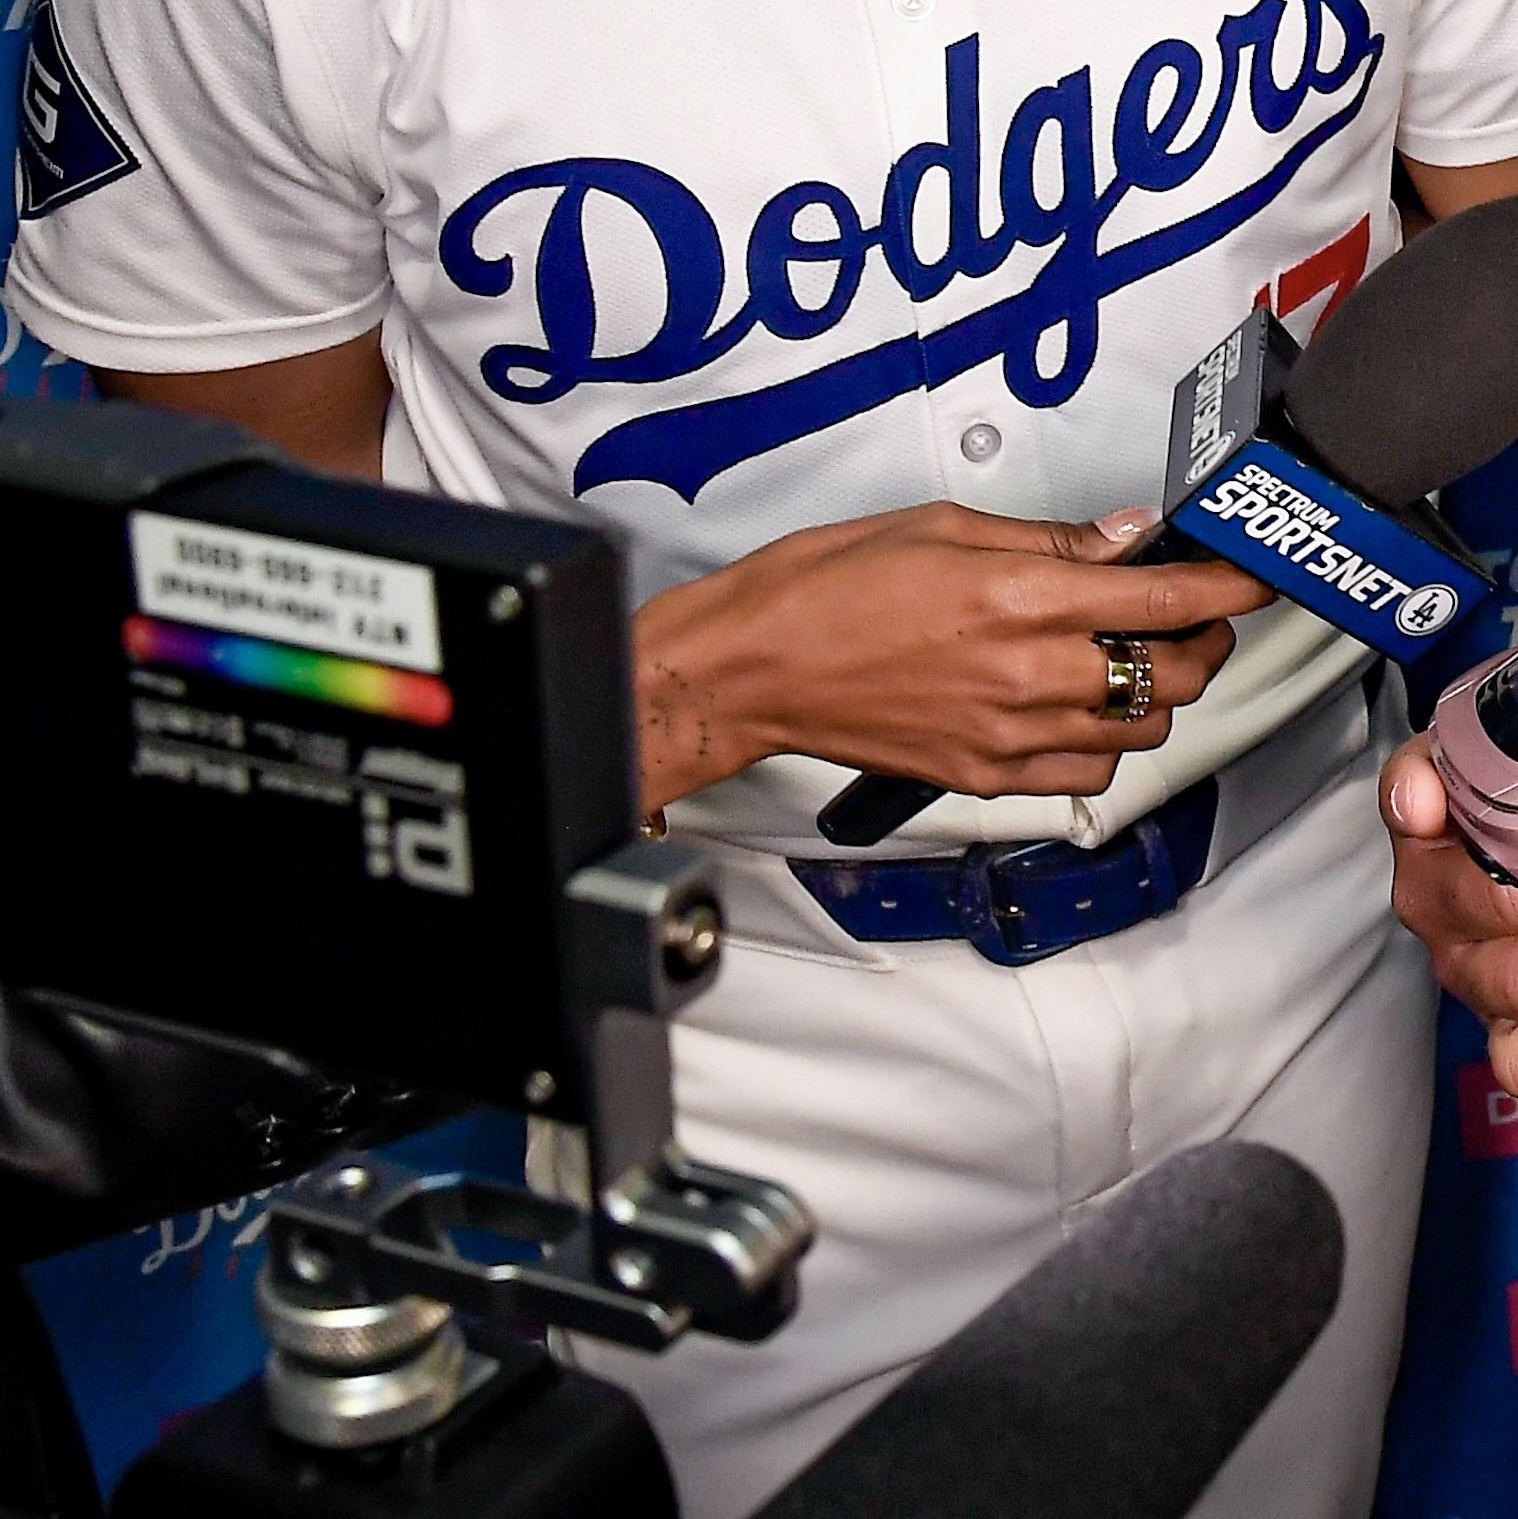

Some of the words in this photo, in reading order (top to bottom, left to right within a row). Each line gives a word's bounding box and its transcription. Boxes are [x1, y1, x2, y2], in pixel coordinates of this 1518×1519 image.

[1254, 212, 1371, 354] 7
[1198, 480, 1414, 611] SPORTSNET
[1233, 464, 1341, 532] SPECTRUM
